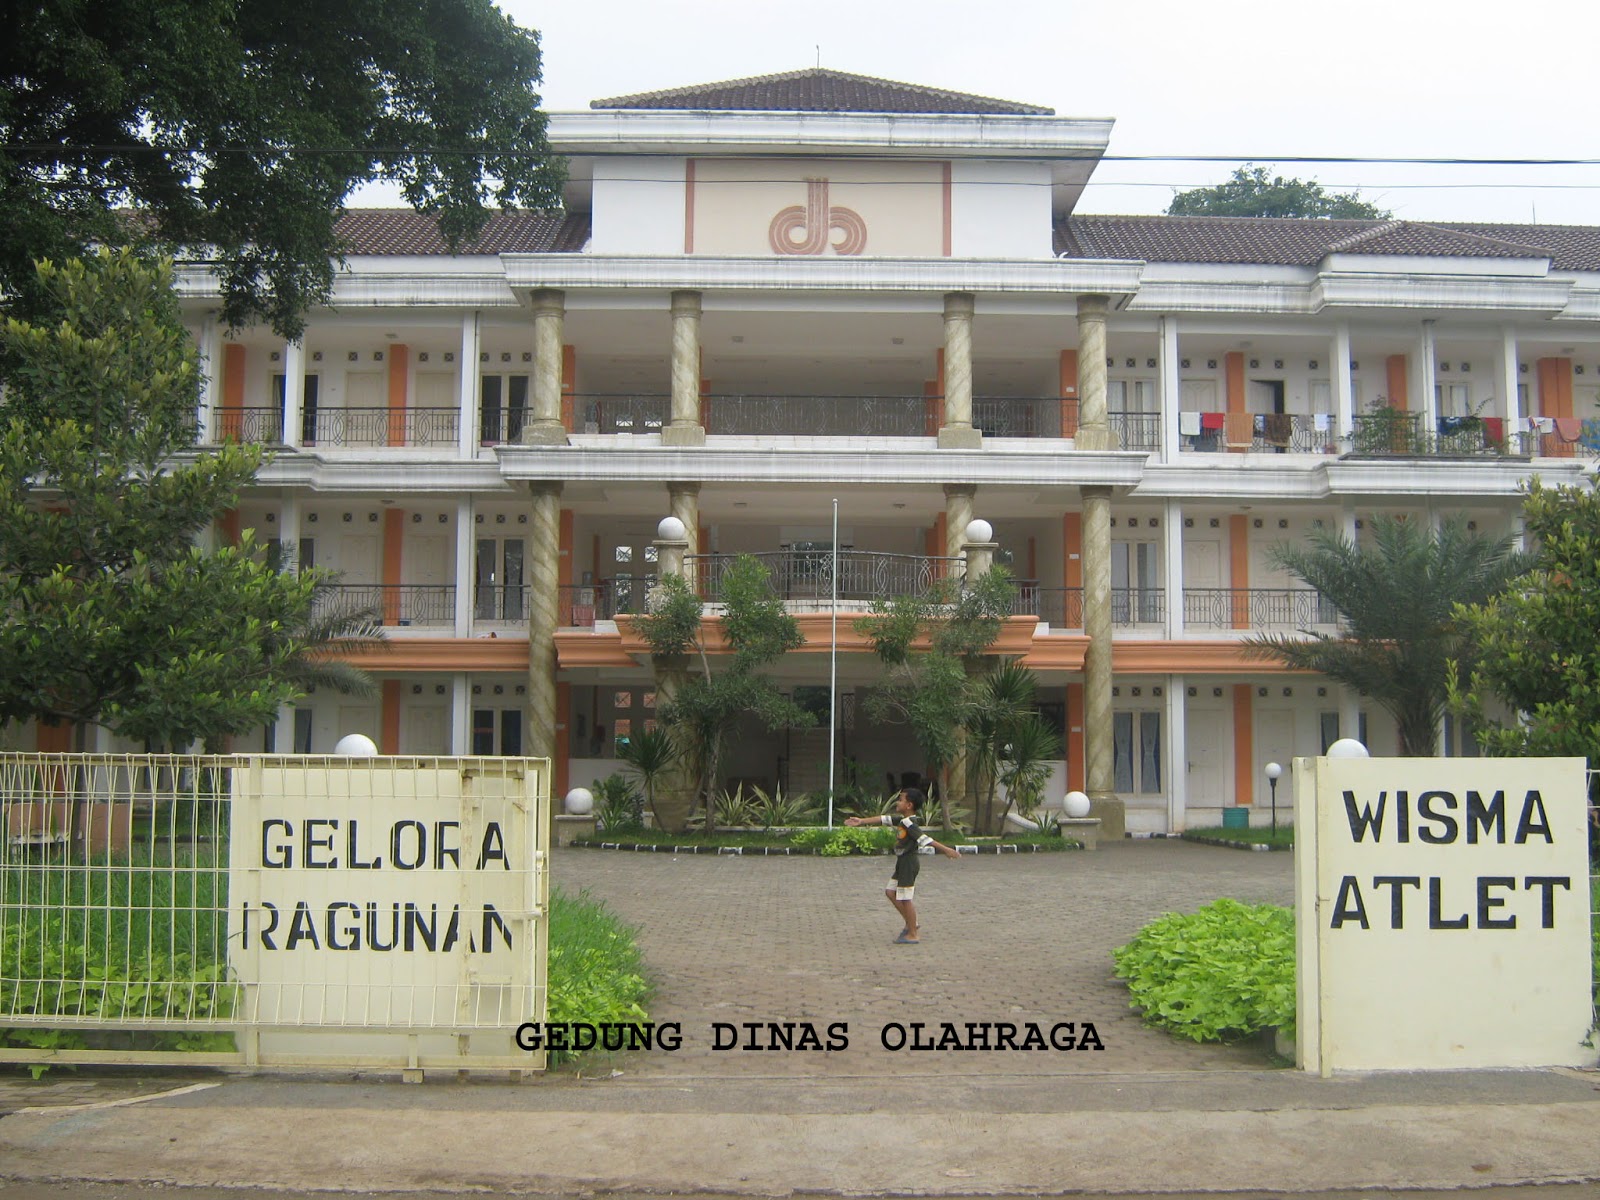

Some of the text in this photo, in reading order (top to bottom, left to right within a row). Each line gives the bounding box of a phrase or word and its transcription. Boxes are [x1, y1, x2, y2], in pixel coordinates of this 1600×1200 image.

[1342, 790, 1554, 845] WISMA
[262, 819, 511, 871] GELORA
[242, 901, 513, 954] RAGUNAN
[1330, 875, 1571, 930] ATLET
